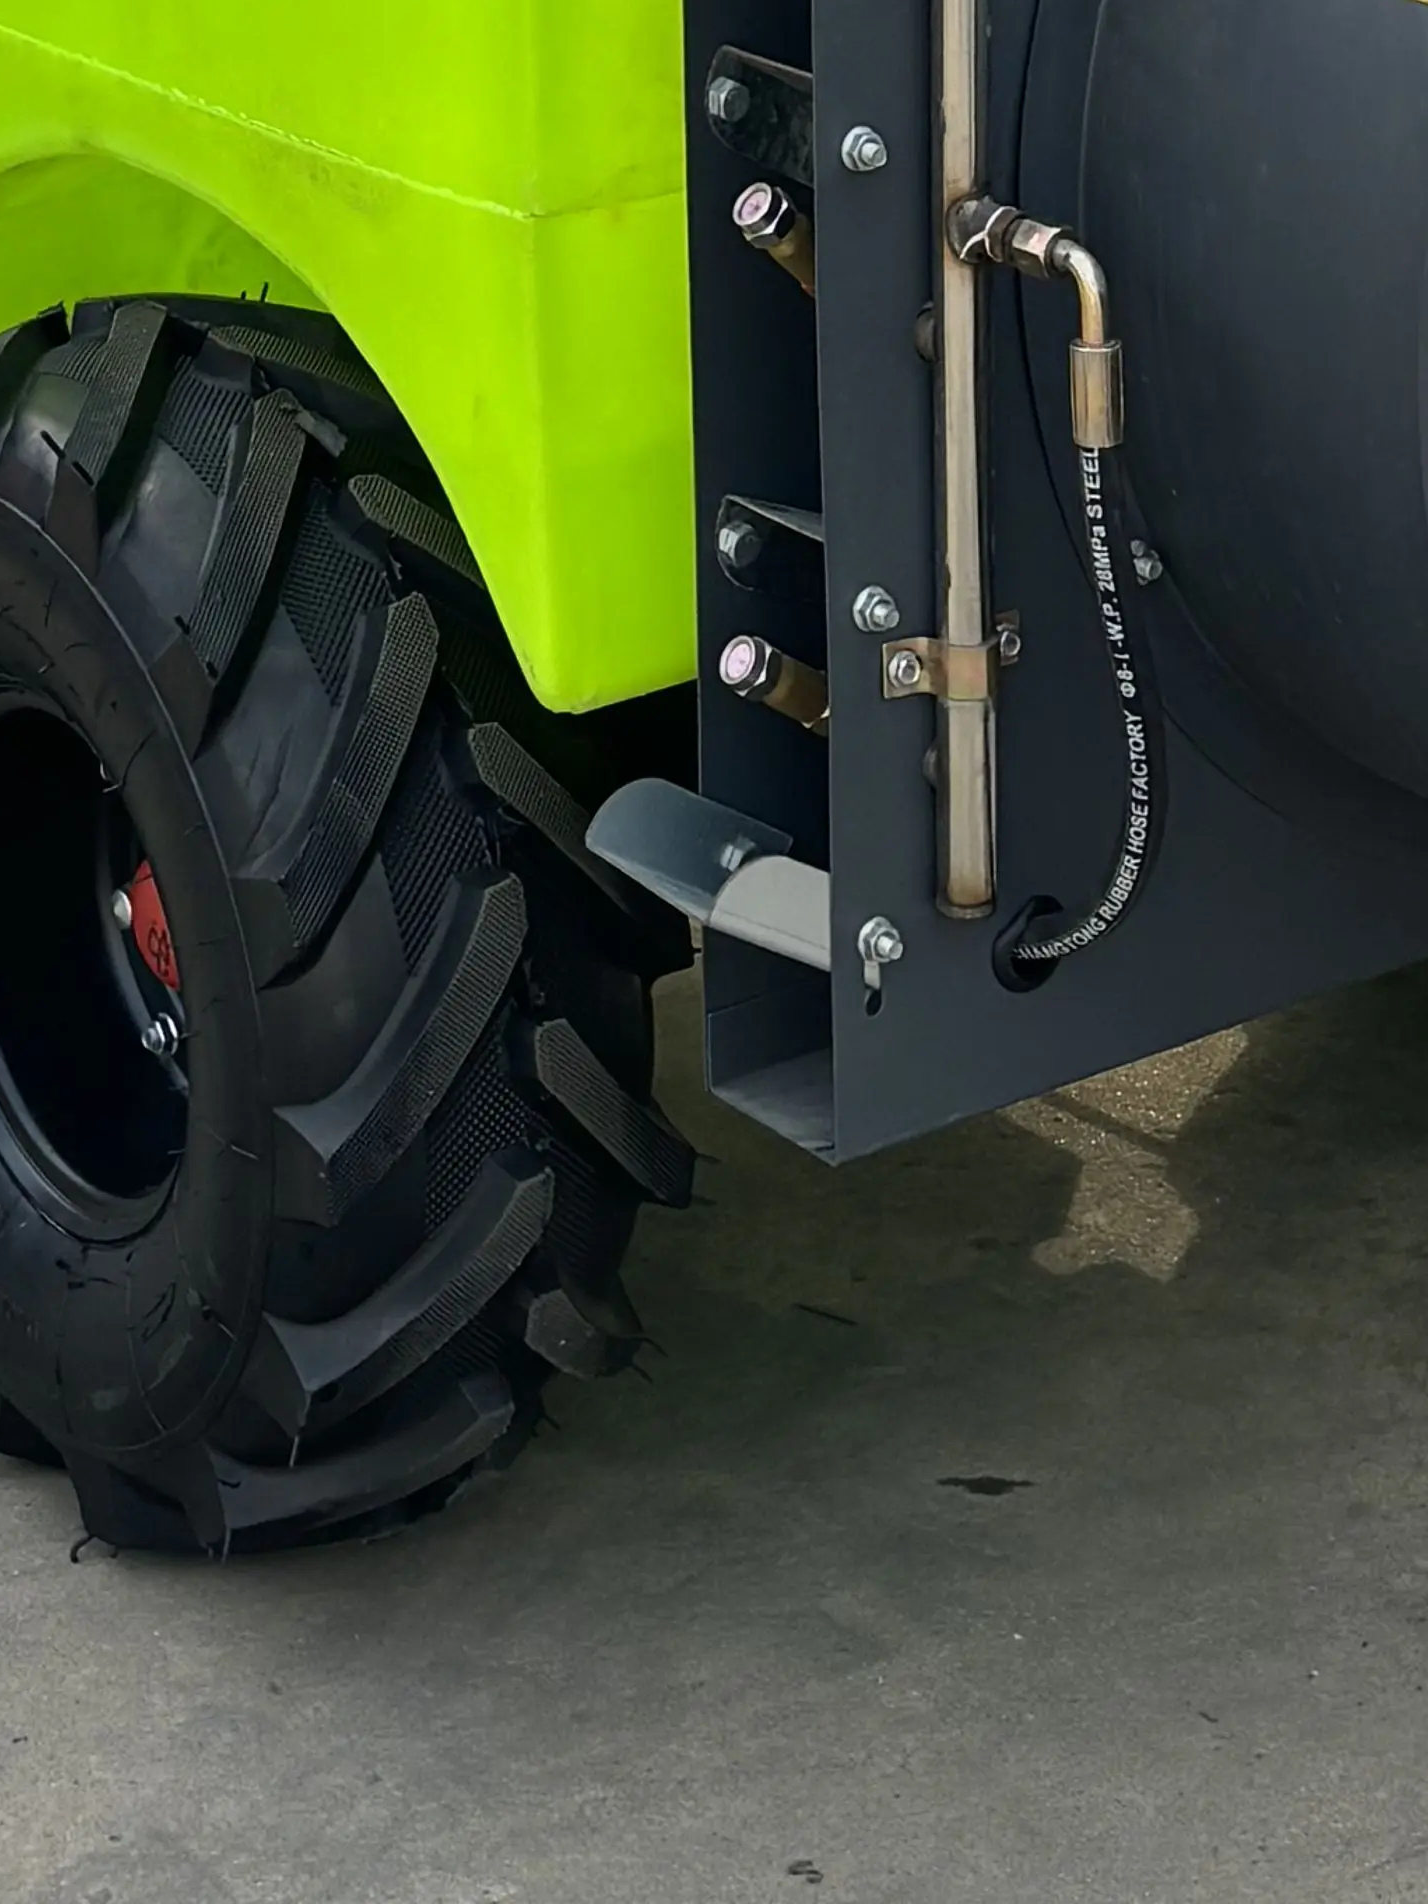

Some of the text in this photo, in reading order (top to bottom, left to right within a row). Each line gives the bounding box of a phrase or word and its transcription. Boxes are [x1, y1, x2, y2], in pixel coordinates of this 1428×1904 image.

[1081, 448, 1103, 519] STEEL
[1091, 525, 1116, 592] 28MPa
[1124, 709, 1149, 800] FACTORY
[1127, 802, 1149, 854] HOSE
[1099, 854, 1141, 922] RUBBER
[1014, 916, 1107, 961] HANGTONG
